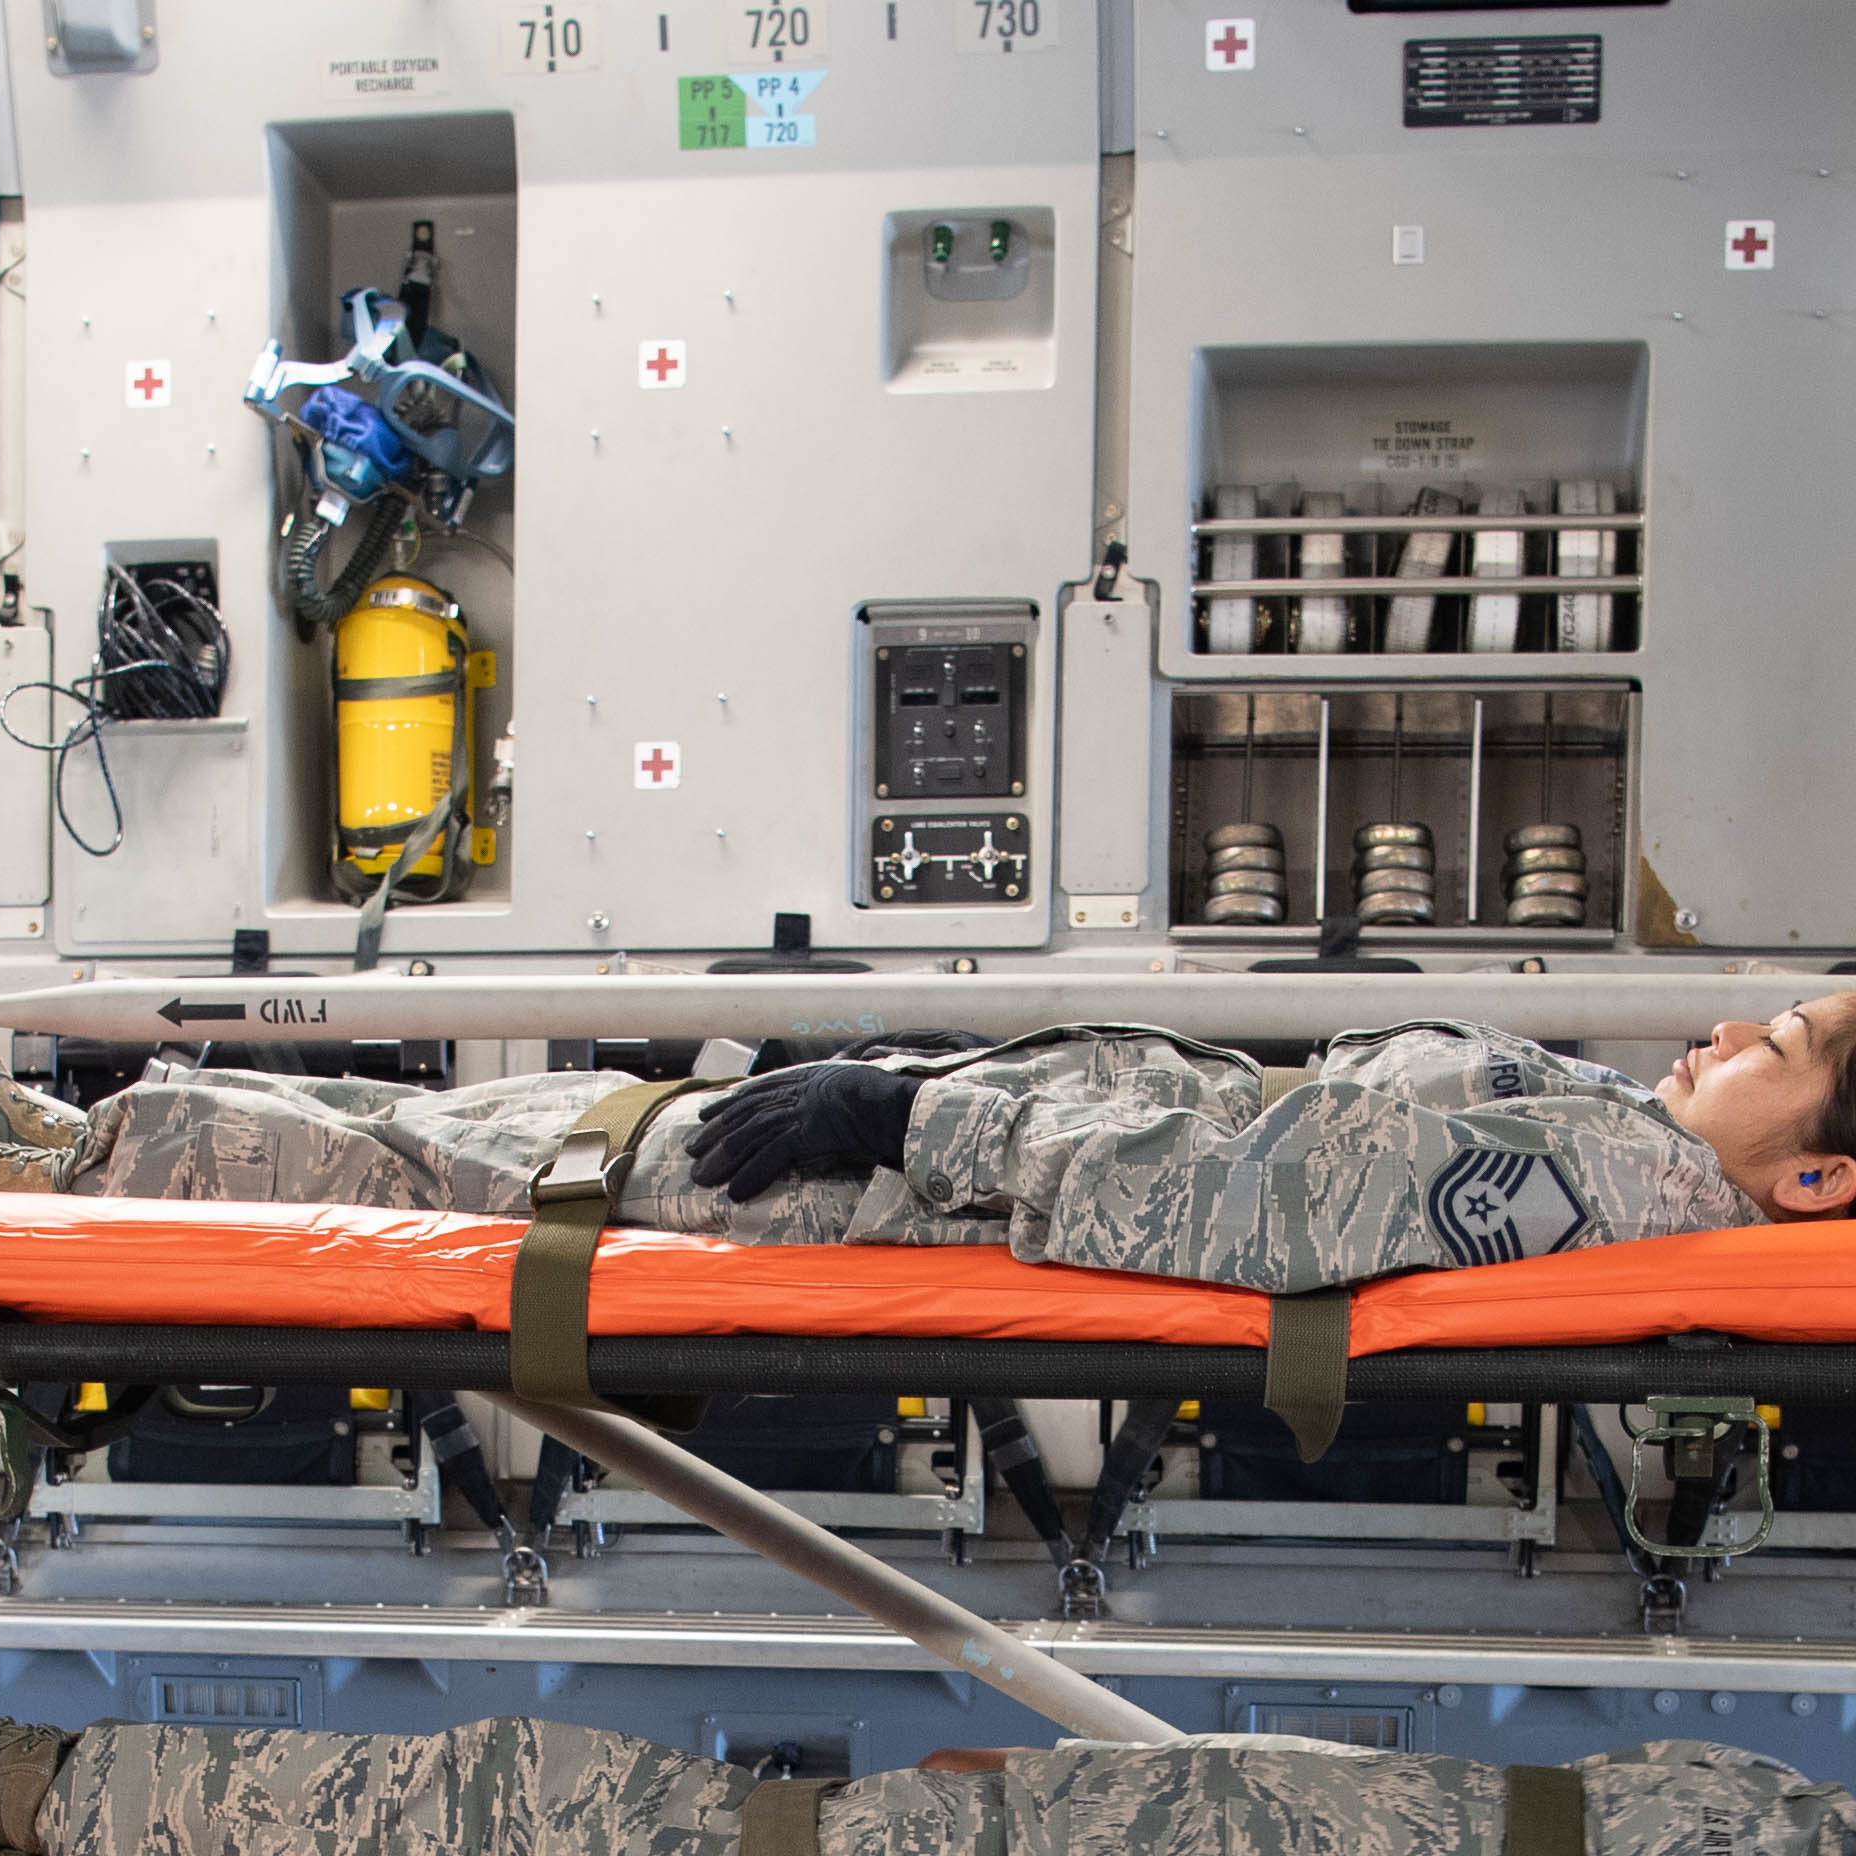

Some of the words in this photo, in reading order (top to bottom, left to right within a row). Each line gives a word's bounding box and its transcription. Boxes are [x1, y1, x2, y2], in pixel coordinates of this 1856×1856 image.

[746, 9, 810, 48] 720
[975, 0, 1041, 38] 730
[519, 20, 582, 59] 710
[329, 60, 387, 75] PORTABLE
[392, 58, 439, 72] OXYGEN
[355, 77, 414, 92] RECHARGE
[690, 79, 715, 100] PP
[721, 79, 733, 99] 5
[757, 77, 782, 97] PP
[789, 76, 800, 95] 4
[696, 124, 730, 146] 717
[764, 122, 799, 143] 720
[1395, 421, 1451, 433] STOWAGE
[1373, 438, 1391, 451] TIE
[1395, 438, 1431, 450] DOWN
[1436, 437, 1475, 450] STRAP
[259, 998, 327, 1024] FWD
[1703, 1828, 1732, 1847] AIR
